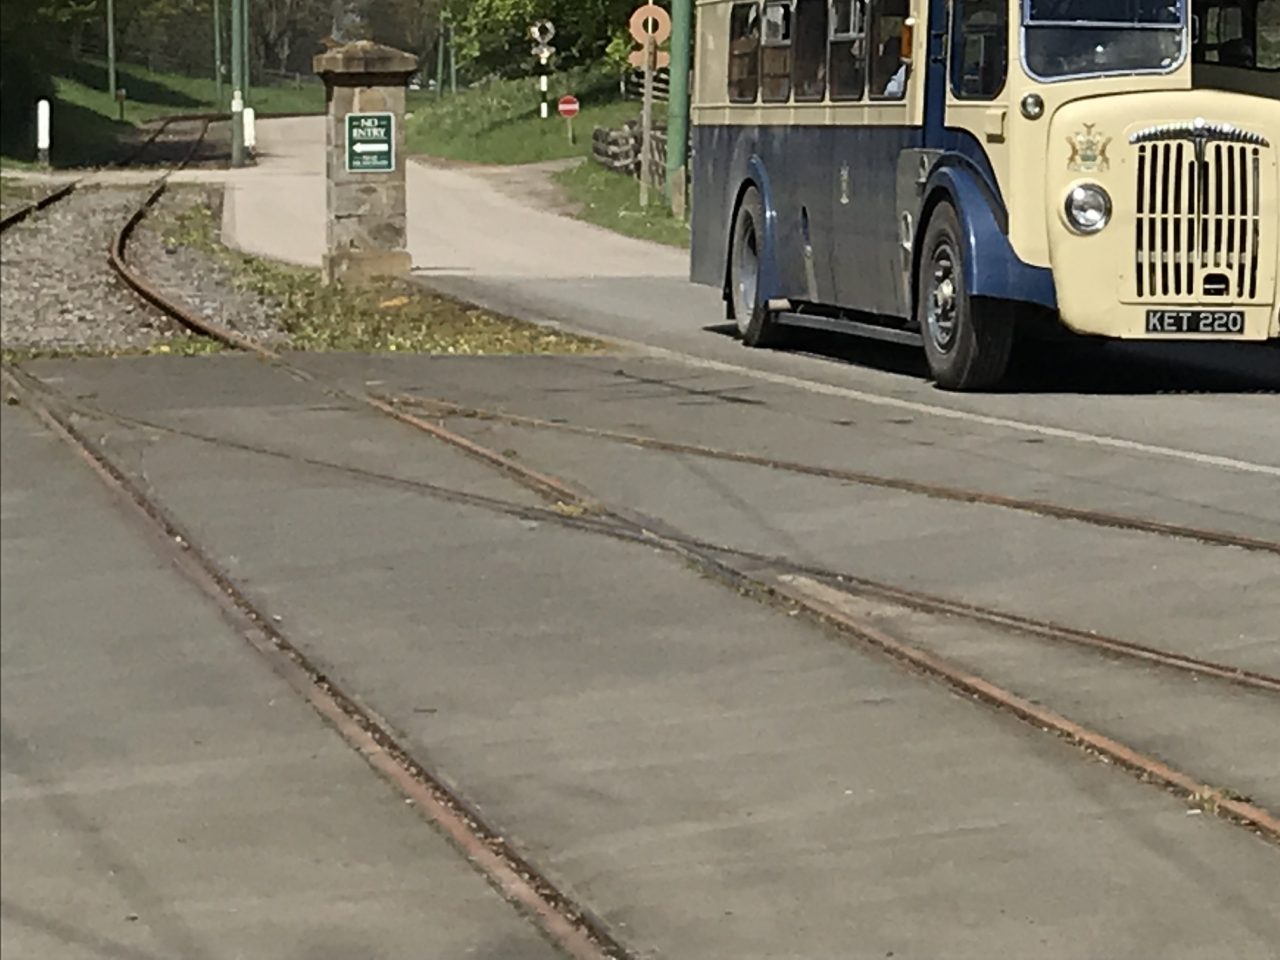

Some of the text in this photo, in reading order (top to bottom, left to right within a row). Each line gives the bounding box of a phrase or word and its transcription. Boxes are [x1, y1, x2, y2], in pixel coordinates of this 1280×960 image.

[361, 118, 379, 127] NO
[352, 127, 386, 138] ENTRY
[1148, 312, 1242, 331] KET 220
